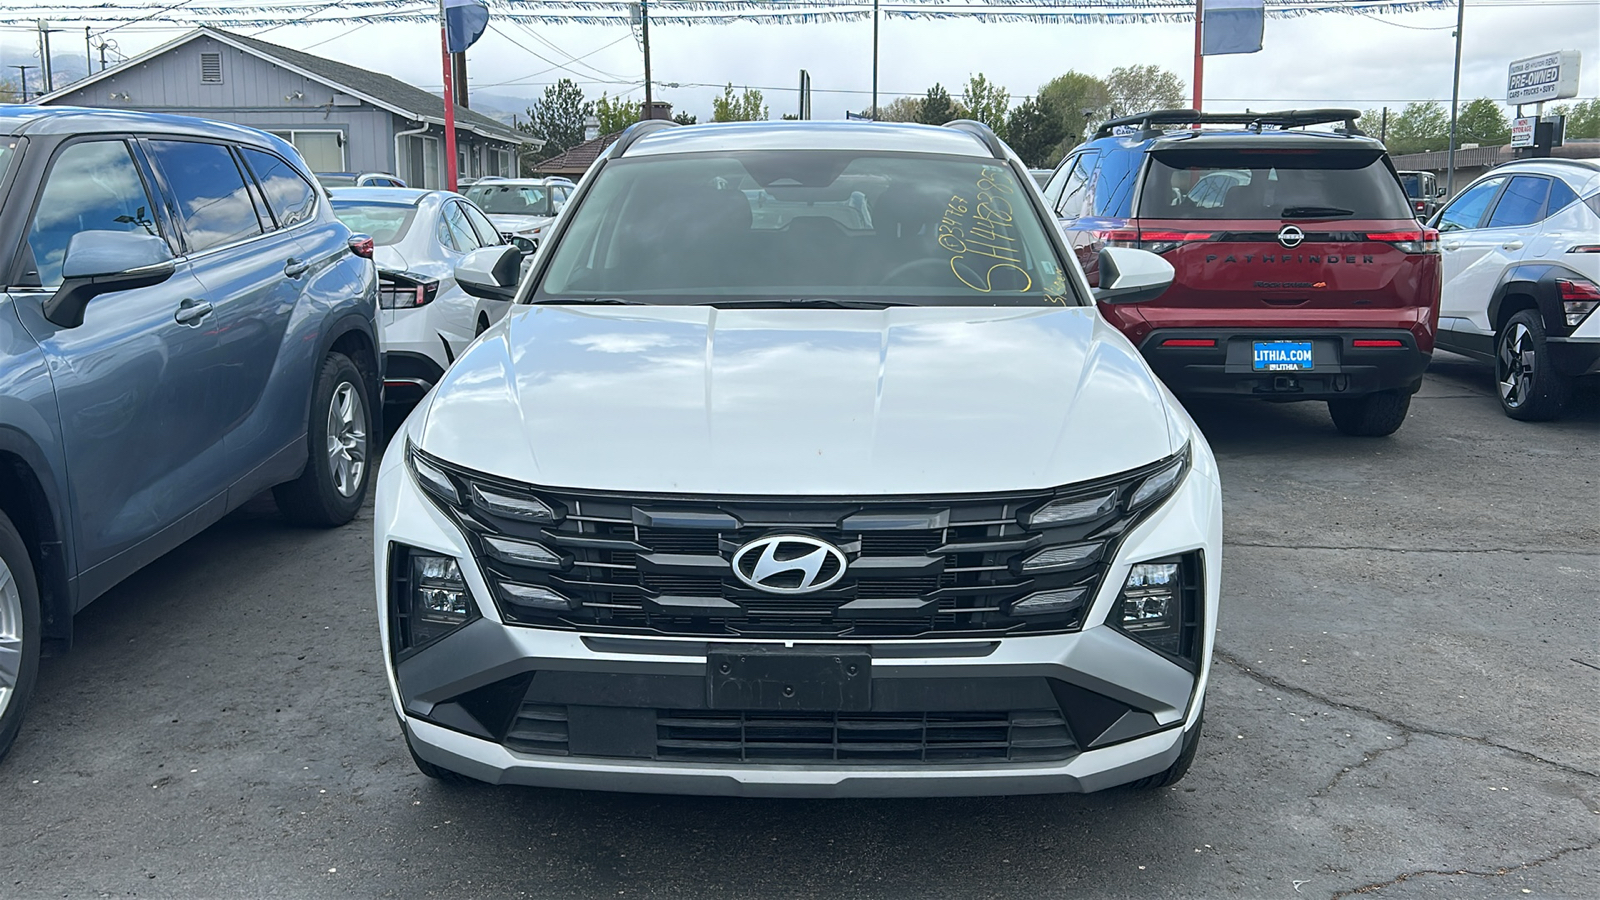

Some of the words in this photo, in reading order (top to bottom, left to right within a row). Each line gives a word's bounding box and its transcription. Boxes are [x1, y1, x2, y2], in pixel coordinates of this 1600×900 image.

[1510, 68, 1558, 89] PRE-OWNED
[1523, 87, 1539, 96] TRUCKS
[1512, 125, 1532, 133] STORAGE
[1206, 254, 1374, 263] PATHFINDER
[1254, 350, 1312, 362] LITHIA.COM
